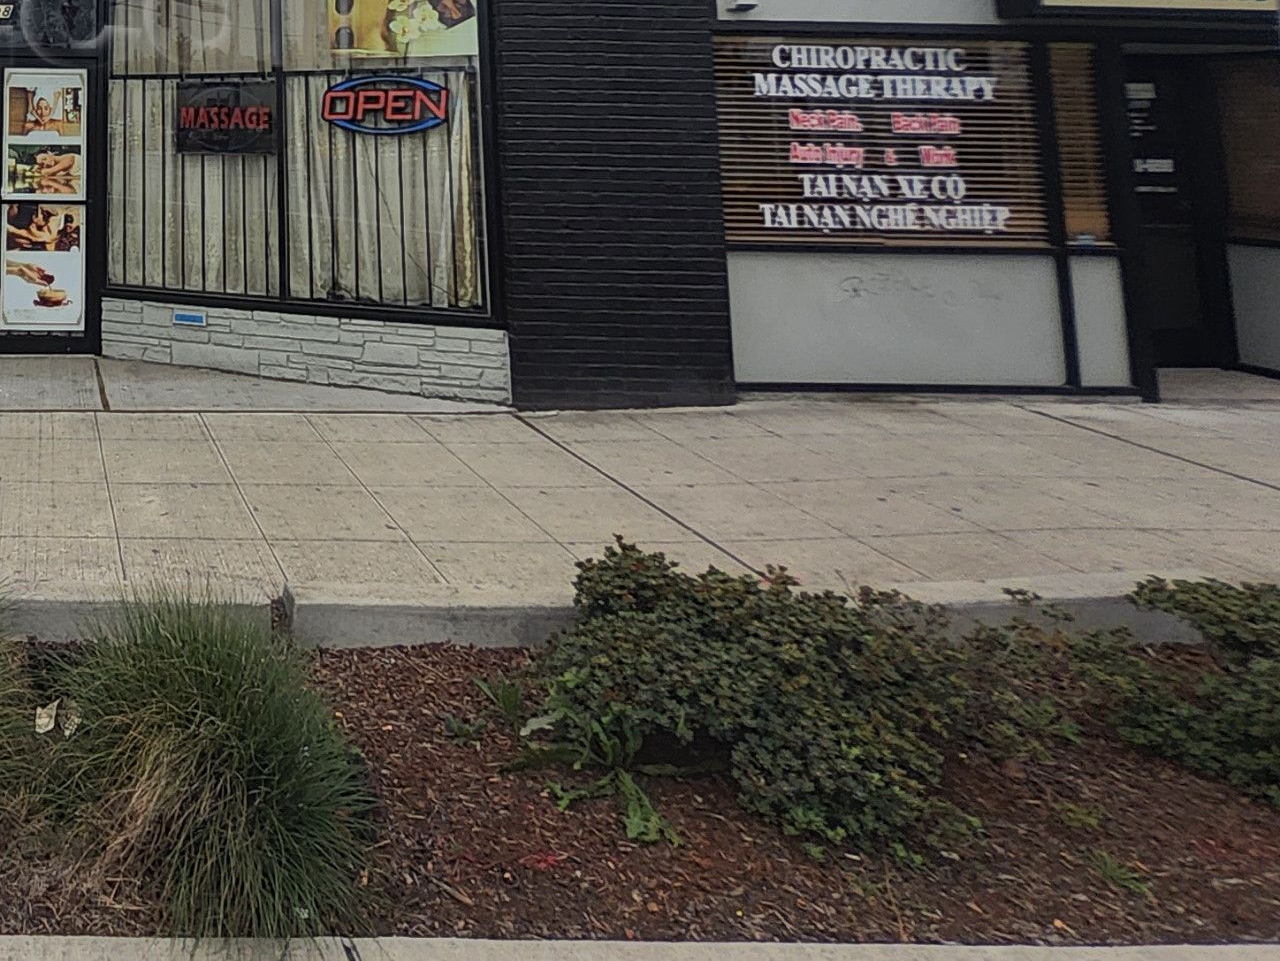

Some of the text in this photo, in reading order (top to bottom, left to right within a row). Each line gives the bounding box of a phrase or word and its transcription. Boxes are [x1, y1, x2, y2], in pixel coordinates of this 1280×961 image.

[771, 44, 968, 71] CHIROPRACTIC
[753, 72, 998, 100] MASSAGE THERAPY
[179, 106, 270, 130] MASSAGE
[322, 88, 448, 121] OPEN
